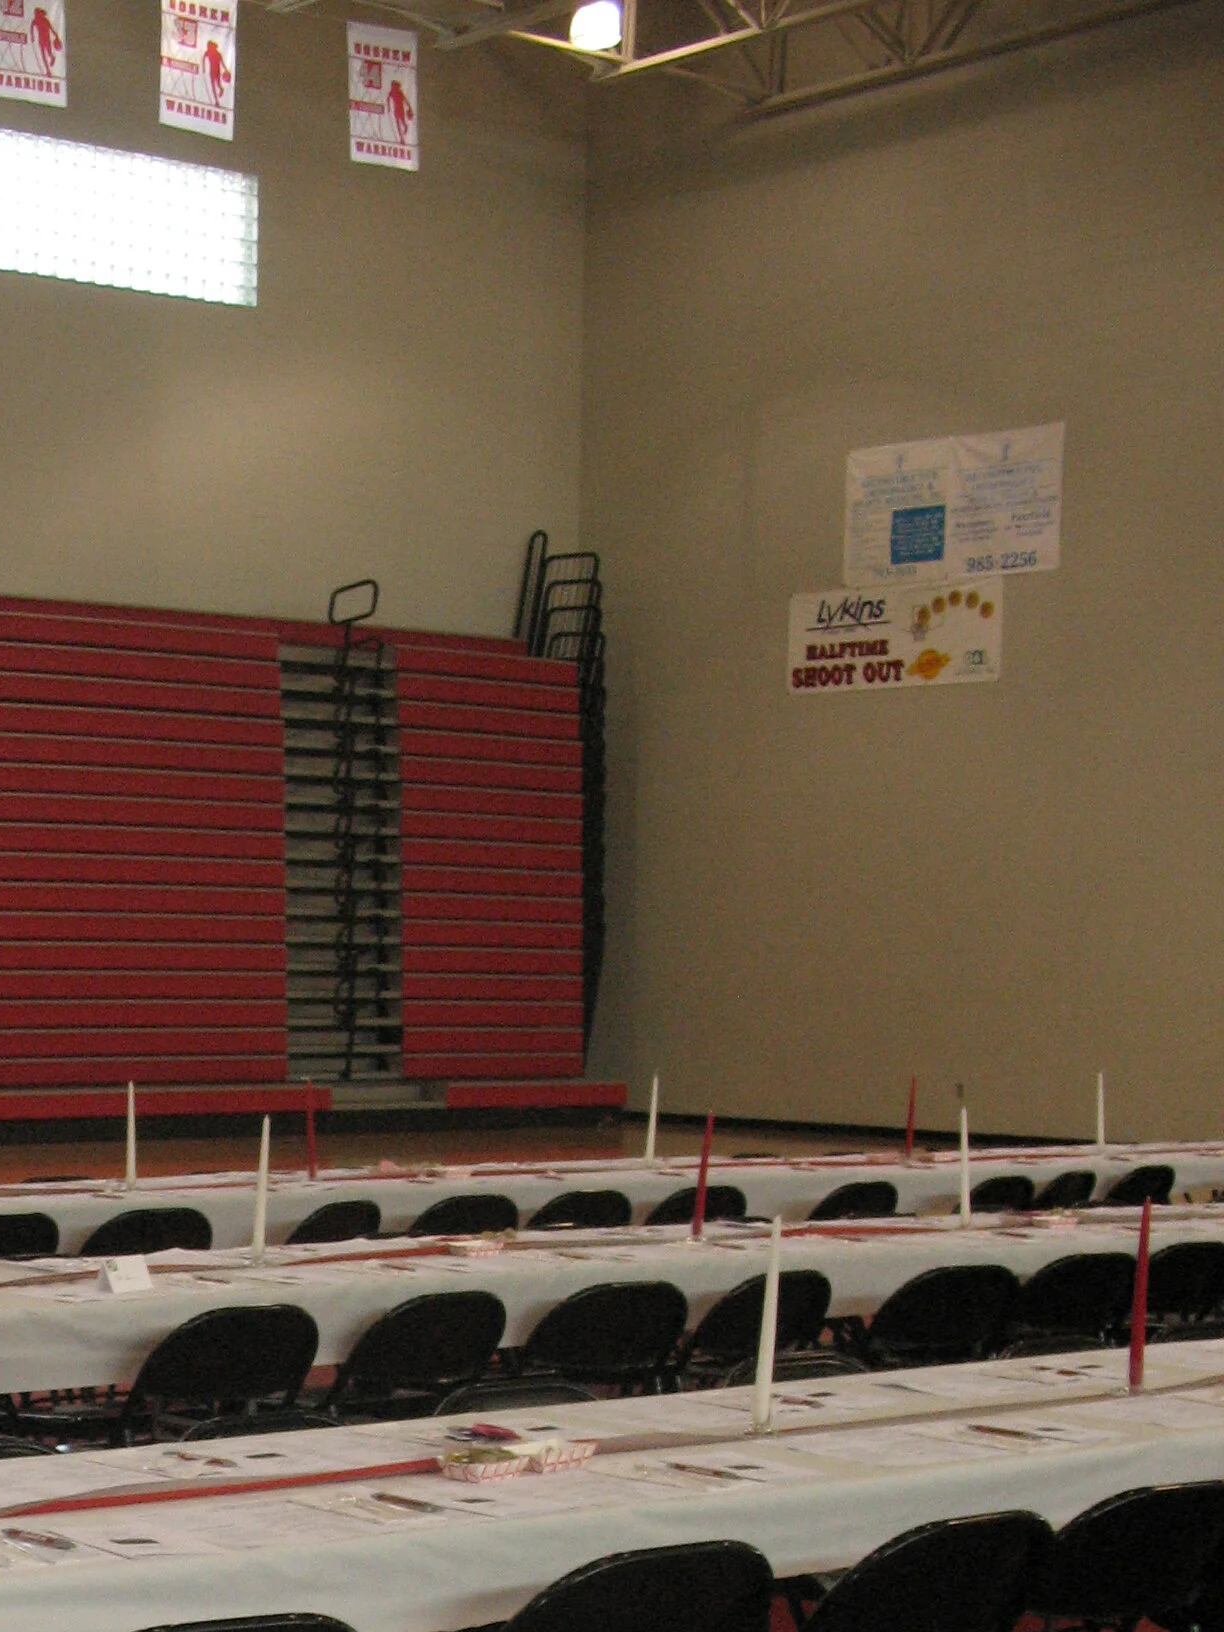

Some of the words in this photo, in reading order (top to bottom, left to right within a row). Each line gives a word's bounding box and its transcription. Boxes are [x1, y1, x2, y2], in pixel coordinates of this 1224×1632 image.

[169, 0, 231, 23] GOSHEN
[353, 43, 412, 63] GOSHEN
[165, 99, 227, 125] WARRIORS
[355, 140, 412, 160] WARRIORS
[806, 639, 889, 661] HALFTIME
[791, 664, 857, 689] SHOOT
[862, 659, 905, 683] OUT
